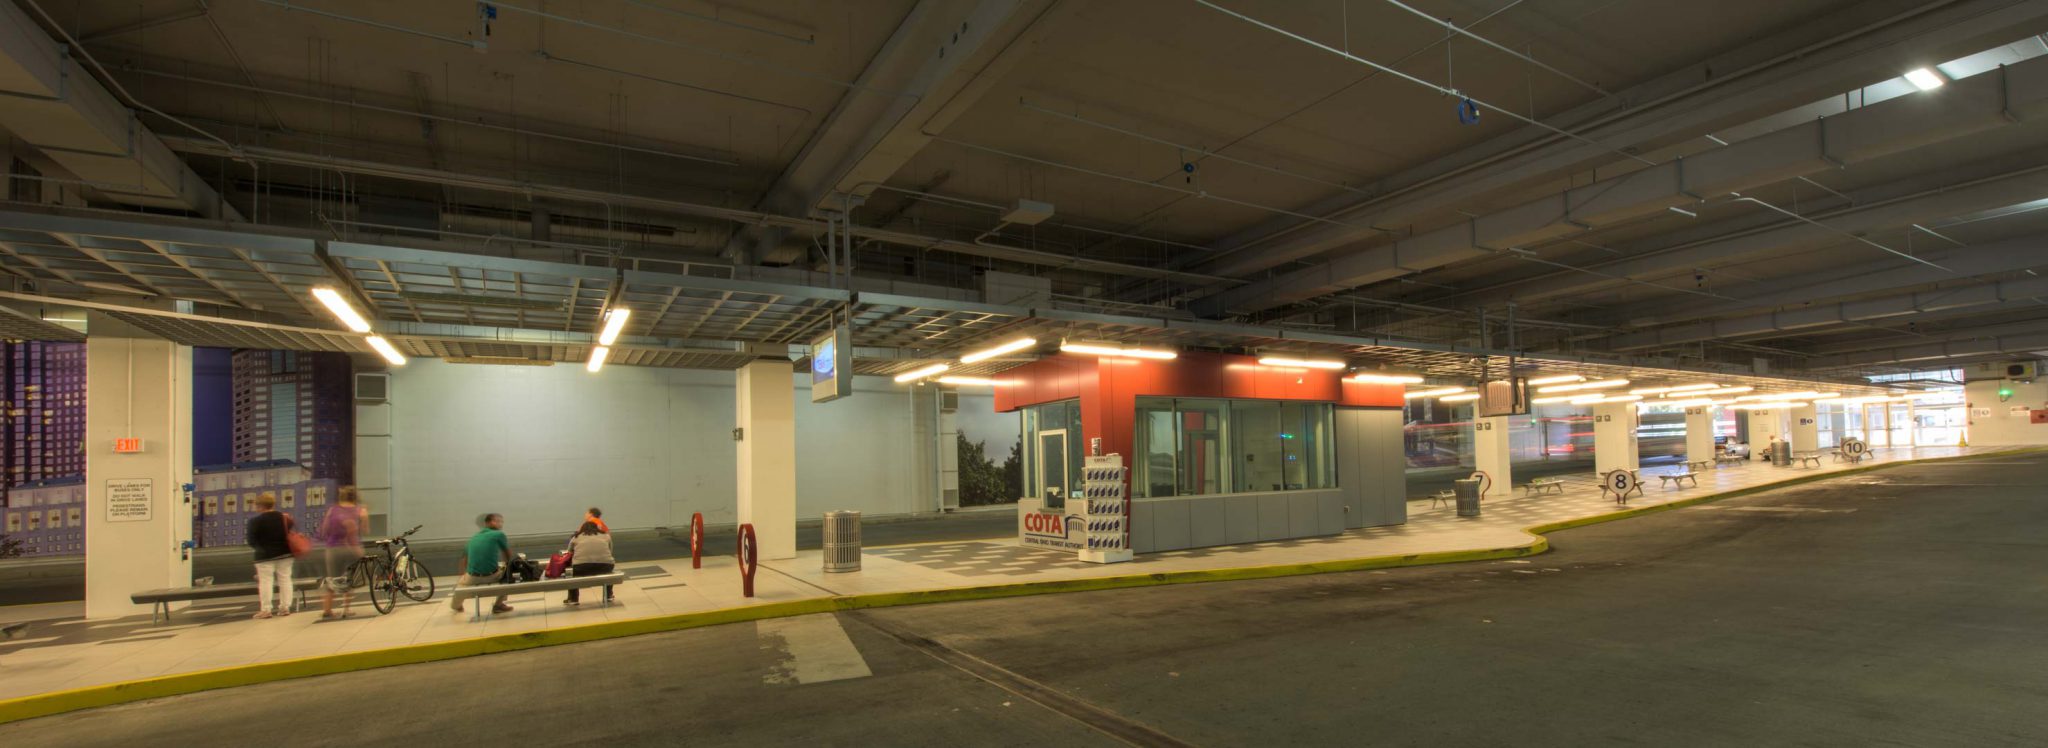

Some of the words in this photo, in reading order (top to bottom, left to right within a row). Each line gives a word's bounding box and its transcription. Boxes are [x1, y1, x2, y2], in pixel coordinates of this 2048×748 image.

[117, 438, 139, 450] EXIT
[1846, 442, 1863, 453] 10
[1474, 475, 1483, 485] 7
[1615, 474, 1626, 489] 8
[1025, 513, 1062, 534] COTA
[744, 534, 750, 564] 6
